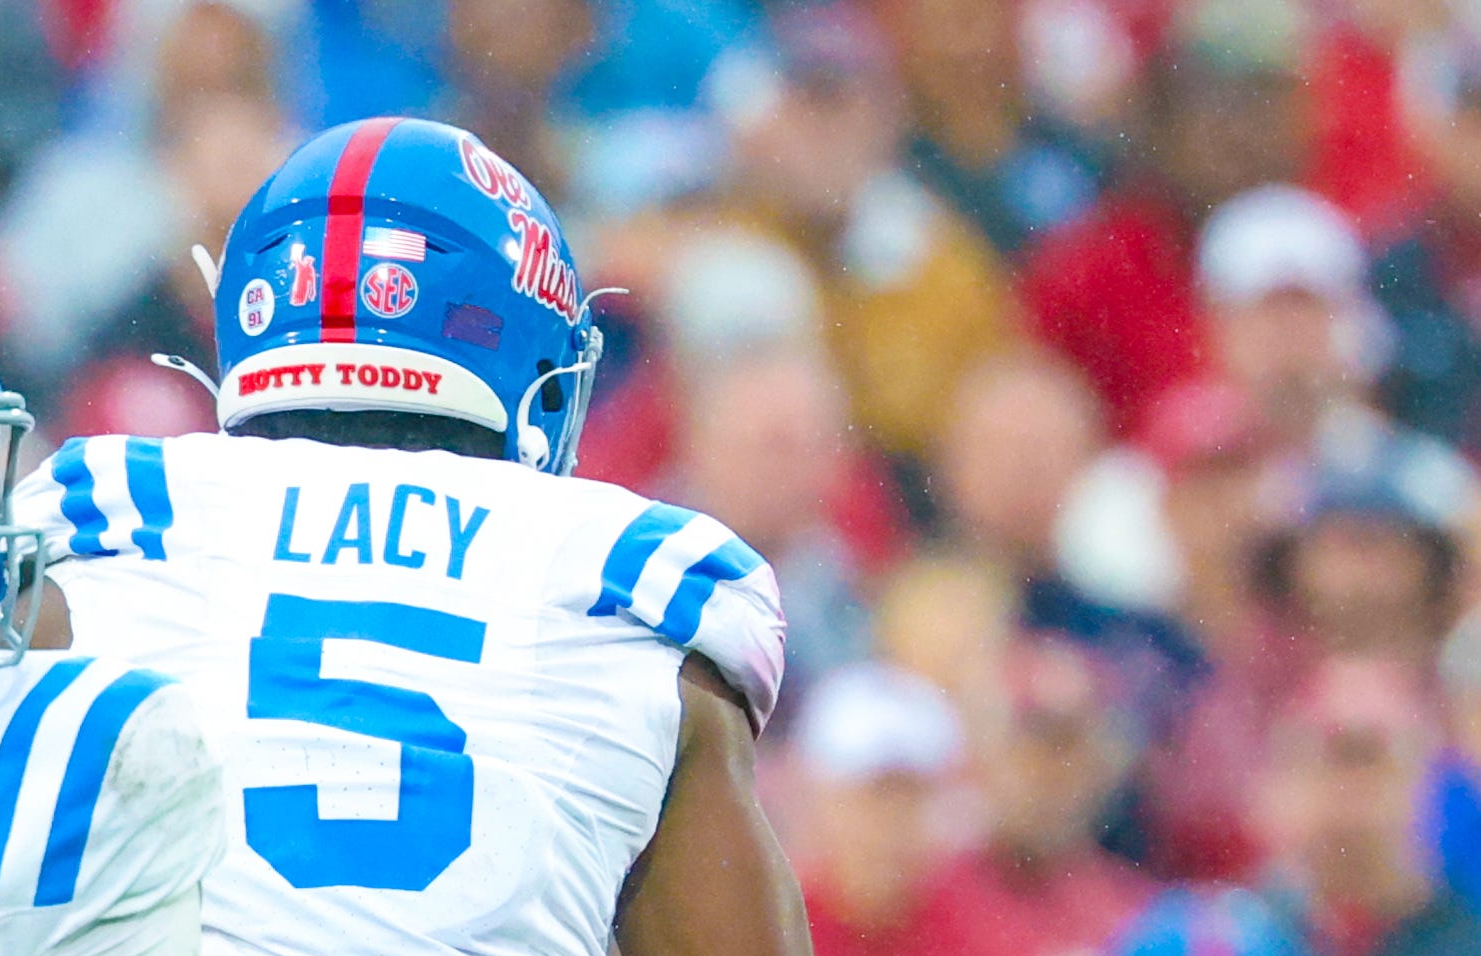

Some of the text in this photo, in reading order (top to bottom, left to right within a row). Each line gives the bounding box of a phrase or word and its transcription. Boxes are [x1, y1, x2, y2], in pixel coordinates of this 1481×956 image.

[461, 137, 530, 208] Ole
[366, 267, 415, 315] SEC
[510, 211, 577, 325] Miss
[247, 310, 263, 328] 91
[238, 363, 443, 397] HOTTY TODDY
[273, 482, 491, 581] LACY
[243, 592, 488, 892] 5
